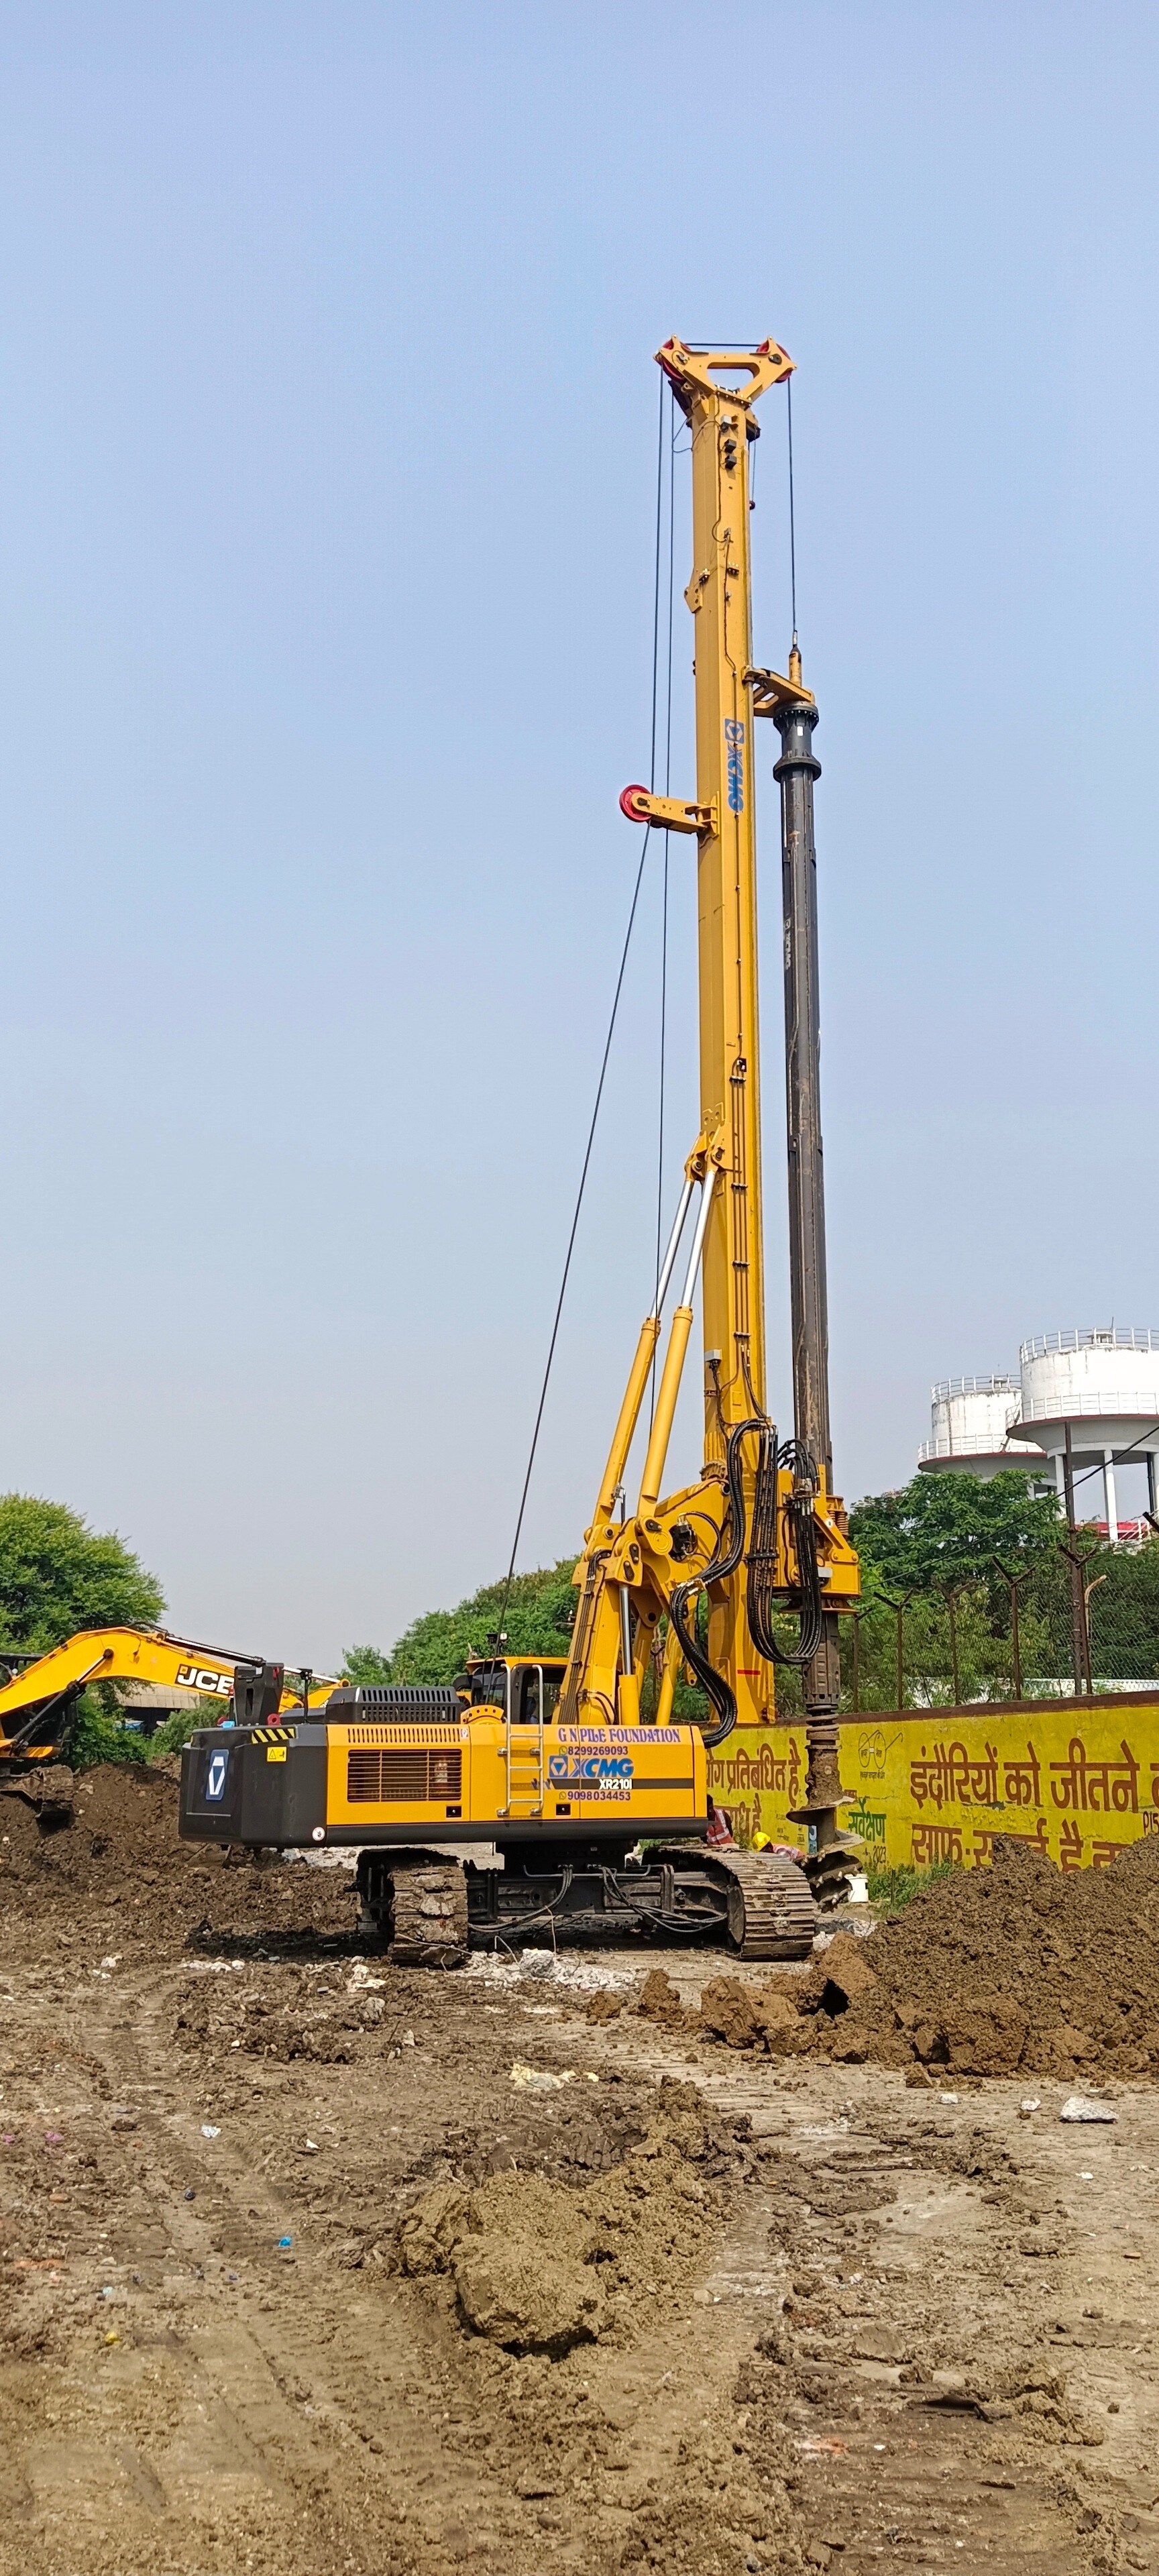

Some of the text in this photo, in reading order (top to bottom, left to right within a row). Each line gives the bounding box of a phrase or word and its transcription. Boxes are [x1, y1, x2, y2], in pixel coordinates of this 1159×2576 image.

[558, 1728, 681, 1743] G N PILE FOUNDATION
[567, 1746, 628, 1756] 8299269093
[569, 1758, 634, 1778] XCMG
[789, 1737, 802, 1808] है
[911, 1741, 999, 1811] इंदौरियों
[1003, 1741, 1041, 1807] को
[1050, 1737, 1140, 1814] जीतने
[567, 1791, 631, 1801] 9098034453
